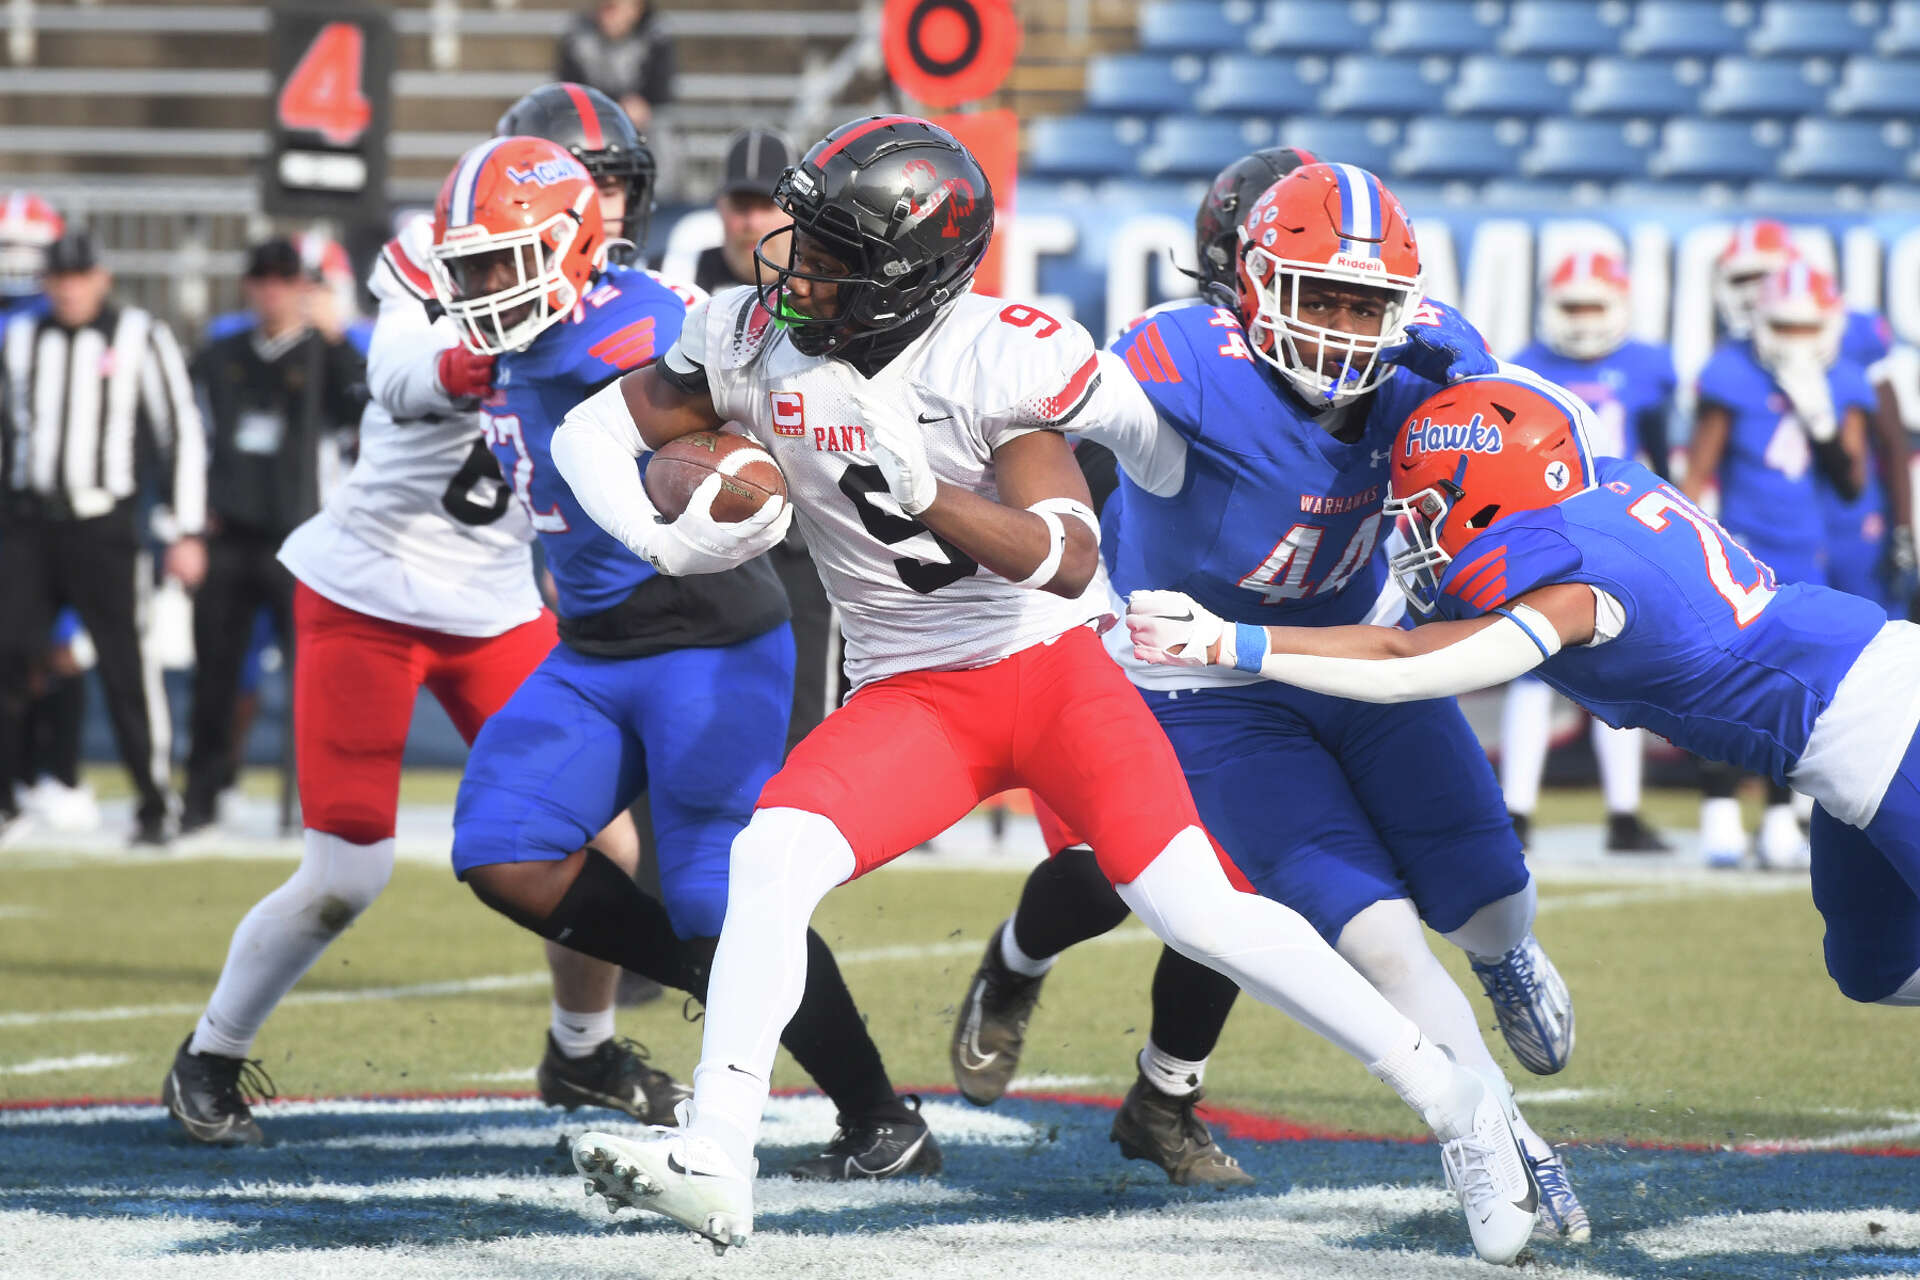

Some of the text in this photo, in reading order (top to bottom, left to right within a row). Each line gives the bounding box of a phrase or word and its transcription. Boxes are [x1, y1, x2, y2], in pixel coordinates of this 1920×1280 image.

[277, 21, 372, 146] 4
[1336, 256, 1381, 272] Riddell
[998, 304, 1063, 339] 9
[769, 391, 804, 427] C
[1405, 412, 1504, 457] Hawks
[1300, 485, 1378, 515] WARHAWKS
[1234, 511, 1384, 607] 44
